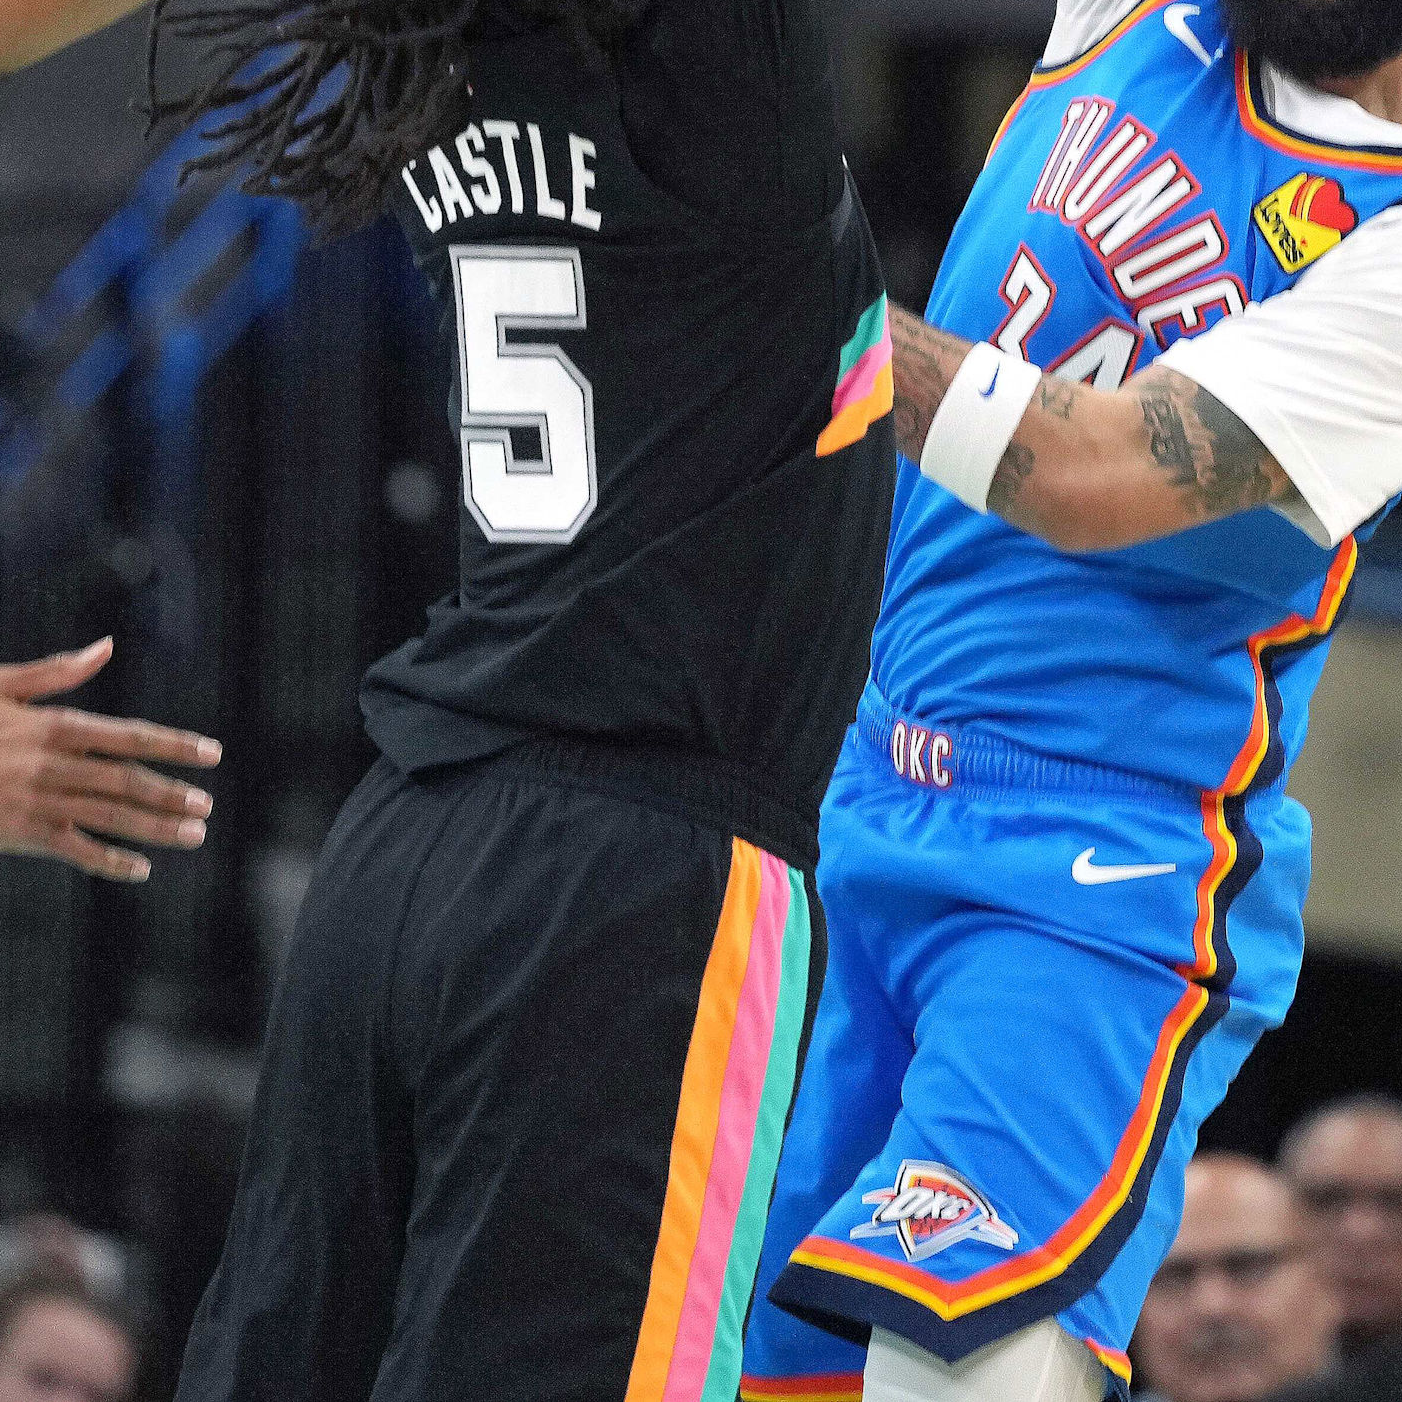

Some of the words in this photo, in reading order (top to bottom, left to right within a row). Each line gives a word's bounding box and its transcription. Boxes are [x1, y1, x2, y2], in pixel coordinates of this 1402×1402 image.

[400, 118, 603, 234] CASTLE
[1028, 96, 1247, 352] THUNDE
[448, 244, 599, 546] 5
[891, 719, 953, 787] OKC
